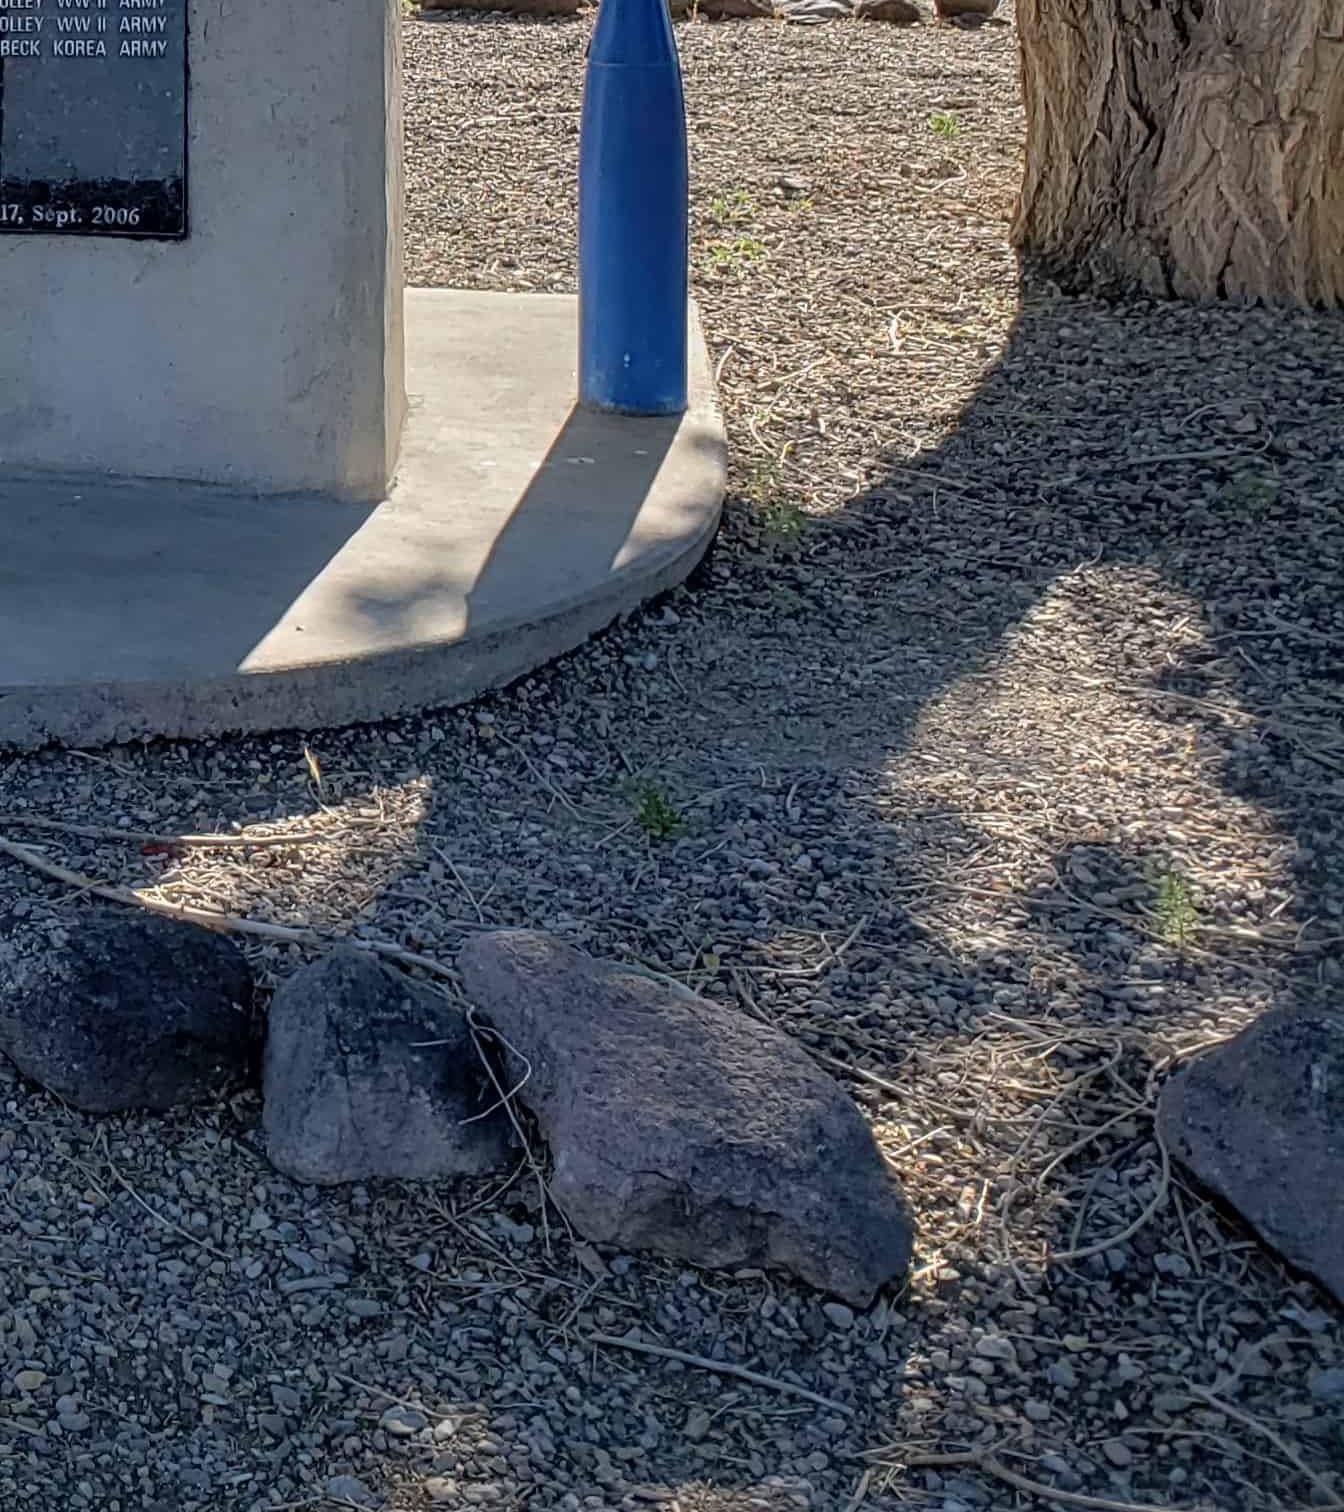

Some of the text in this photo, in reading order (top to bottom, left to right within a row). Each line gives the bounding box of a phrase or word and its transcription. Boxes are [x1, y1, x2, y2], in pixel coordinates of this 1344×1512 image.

[56, 16, 90, 33] WW
[97, 16, 107, 32] II
[119, 16, 166, 33] ARMY
[0, 39, 40, 56] BECK
[53, 39, 107, 56] KOREA
[119, 39, 167, 56] ARMY
[32, 204, 83, 228] Sept.
[91, 207, 141, 226] 2006
